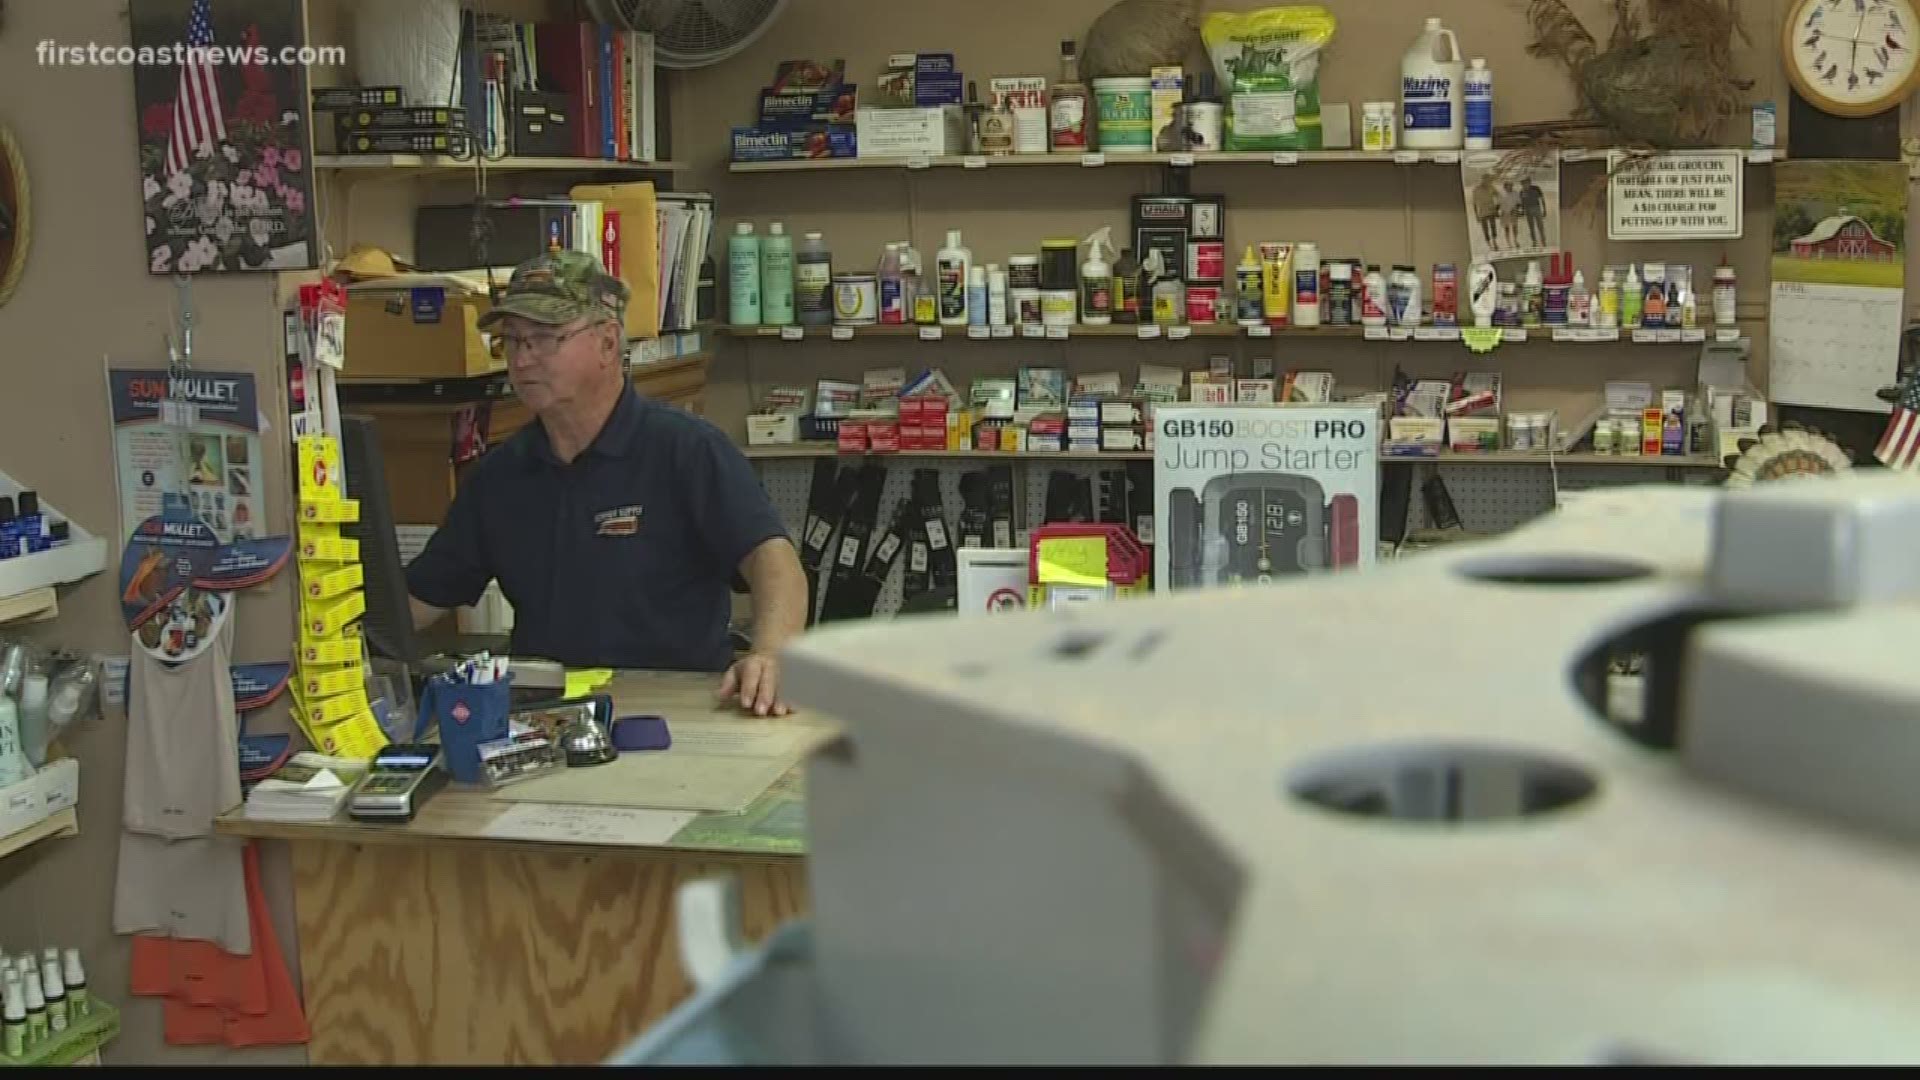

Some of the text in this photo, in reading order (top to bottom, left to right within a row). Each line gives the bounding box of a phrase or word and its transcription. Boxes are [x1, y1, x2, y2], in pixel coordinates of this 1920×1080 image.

[1404, 76, 1451, 91] Wazine
[764, 96, 812, 107] Bimectin
[735, 133, 788, 146] Bimectin
[1659, 161, 1675, 170] ARE
[1665, 175, 1680, 184] OR
[1682, 175, 1702, 186] JUST
[1705, 174, 1733, 184] PLAIN
[1657, 188, 1685, 198] THERE
[1689, 188, 1711, 198] WILL
[1714, 188, 1727, 198] BE
[1632, 203, 1640, 211] A
[1658, 203, 1697, 211] CHARGE
[1699, 203, 1717, 211] FOR
[1621, 217, 1663, 227] PUTTING
[1665, 217, 1679, 226] UP
[1681, 217, 1704, 226] WITH
[129, 380, 166, 398] SUN
[1163, 420, 1234, 438] GB150
[1236, 421, 1310, 438] BOOST
[1314, 421, 1366, 439] PRO
[1165, 442, 1364, 478] Jump Starter
[164, 523, 206, 536] MULLET
[1236, 503, 1248, 544] GB150
